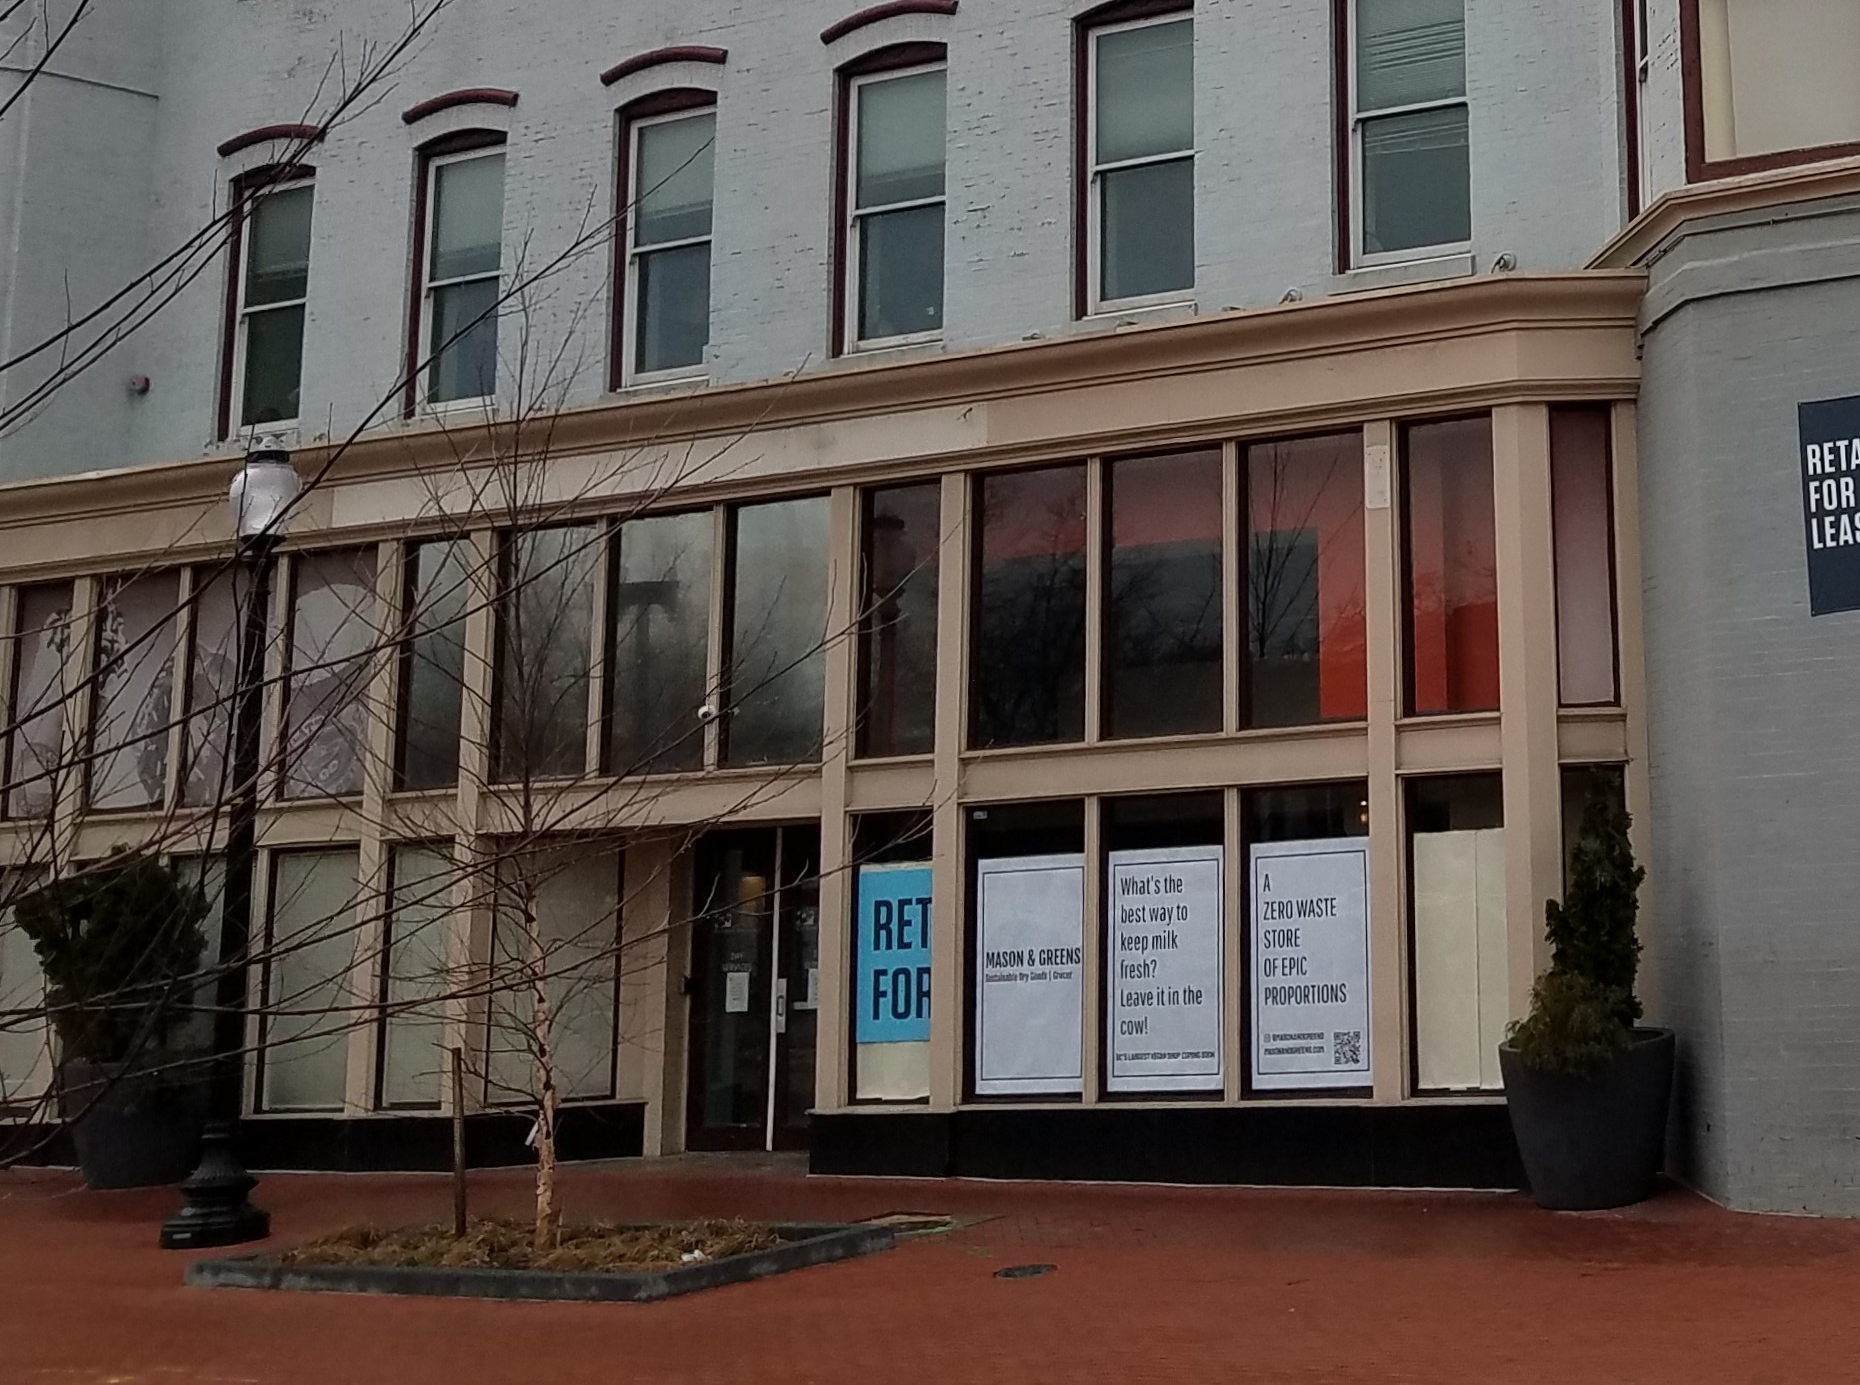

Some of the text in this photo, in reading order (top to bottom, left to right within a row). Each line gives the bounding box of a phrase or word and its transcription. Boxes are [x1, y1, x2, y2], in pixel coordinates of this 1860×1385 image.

[1808, 477, 1856, 513] FOR
[1120, 874, 1183, 896] What's the
[1263, 873, 1271, 892] A
[1121, 904, 1188, 926] best way to
[1263, 897, 1337, 921] ZERO WASTE
[1120, 930, 1178, 954] keep milk
[1263, 928, 1301, 949] STORE
[985, 947, 1081, 969] MASON & GREENS
[1120, 959, 1157, 979] fresh?
[1264, 956, 1307, 977] OF EPIC
[872, 967, 931, 1021] FOR
[1120, 985, 1203, 1007] Leave it in the
[1264, 983, 1347, 1006] PROPORTIONS
[1120, 1016, 1148, 1035] cow!
